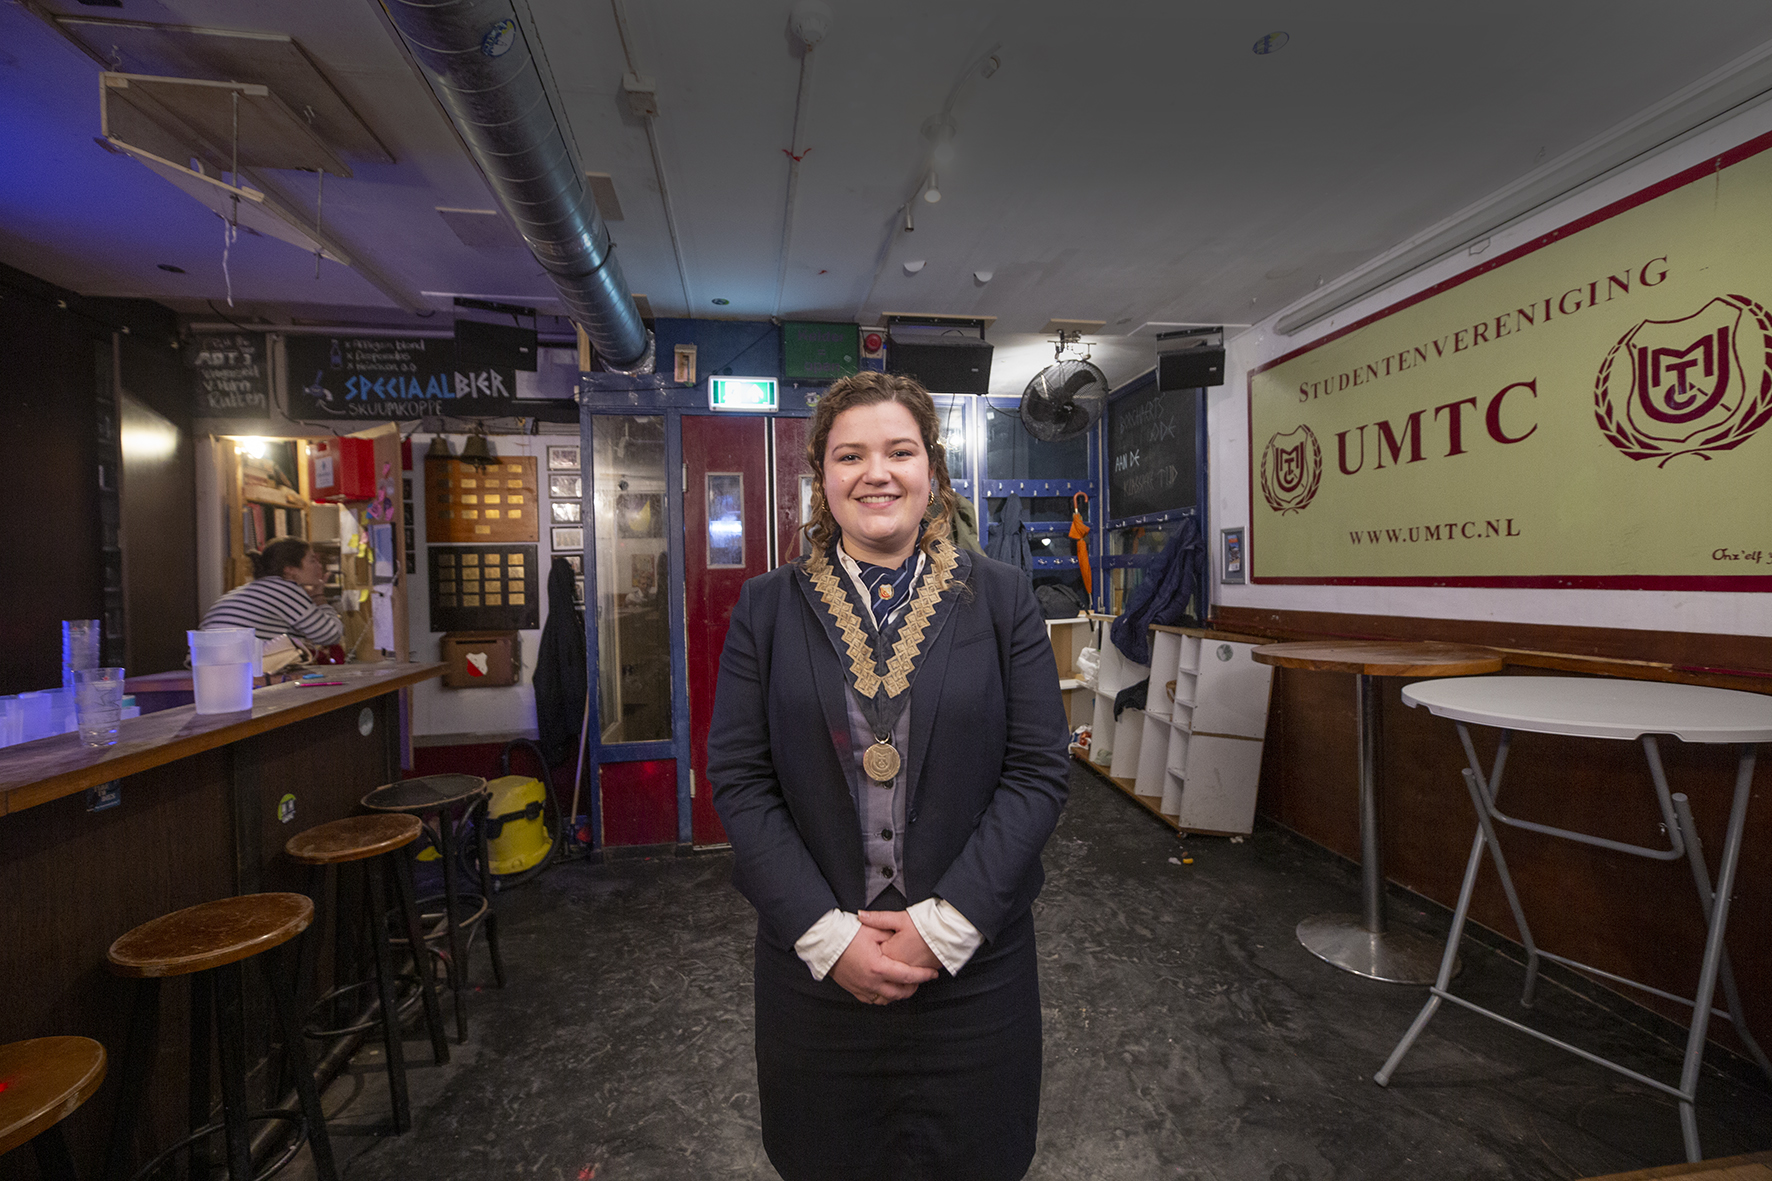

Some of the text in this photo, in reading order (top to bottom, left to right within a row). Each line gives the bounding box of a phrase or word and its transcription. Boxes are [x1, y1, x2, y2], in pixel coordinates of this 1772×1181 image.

[1299, 256, 1670, 402] STUDENTENVERENIGING
[1129, 448, 1141, 468] DE
[1334, 377, 1539, 476] UMTC
[1349, 518, 1521, 545] WWW.UMTC.NL
